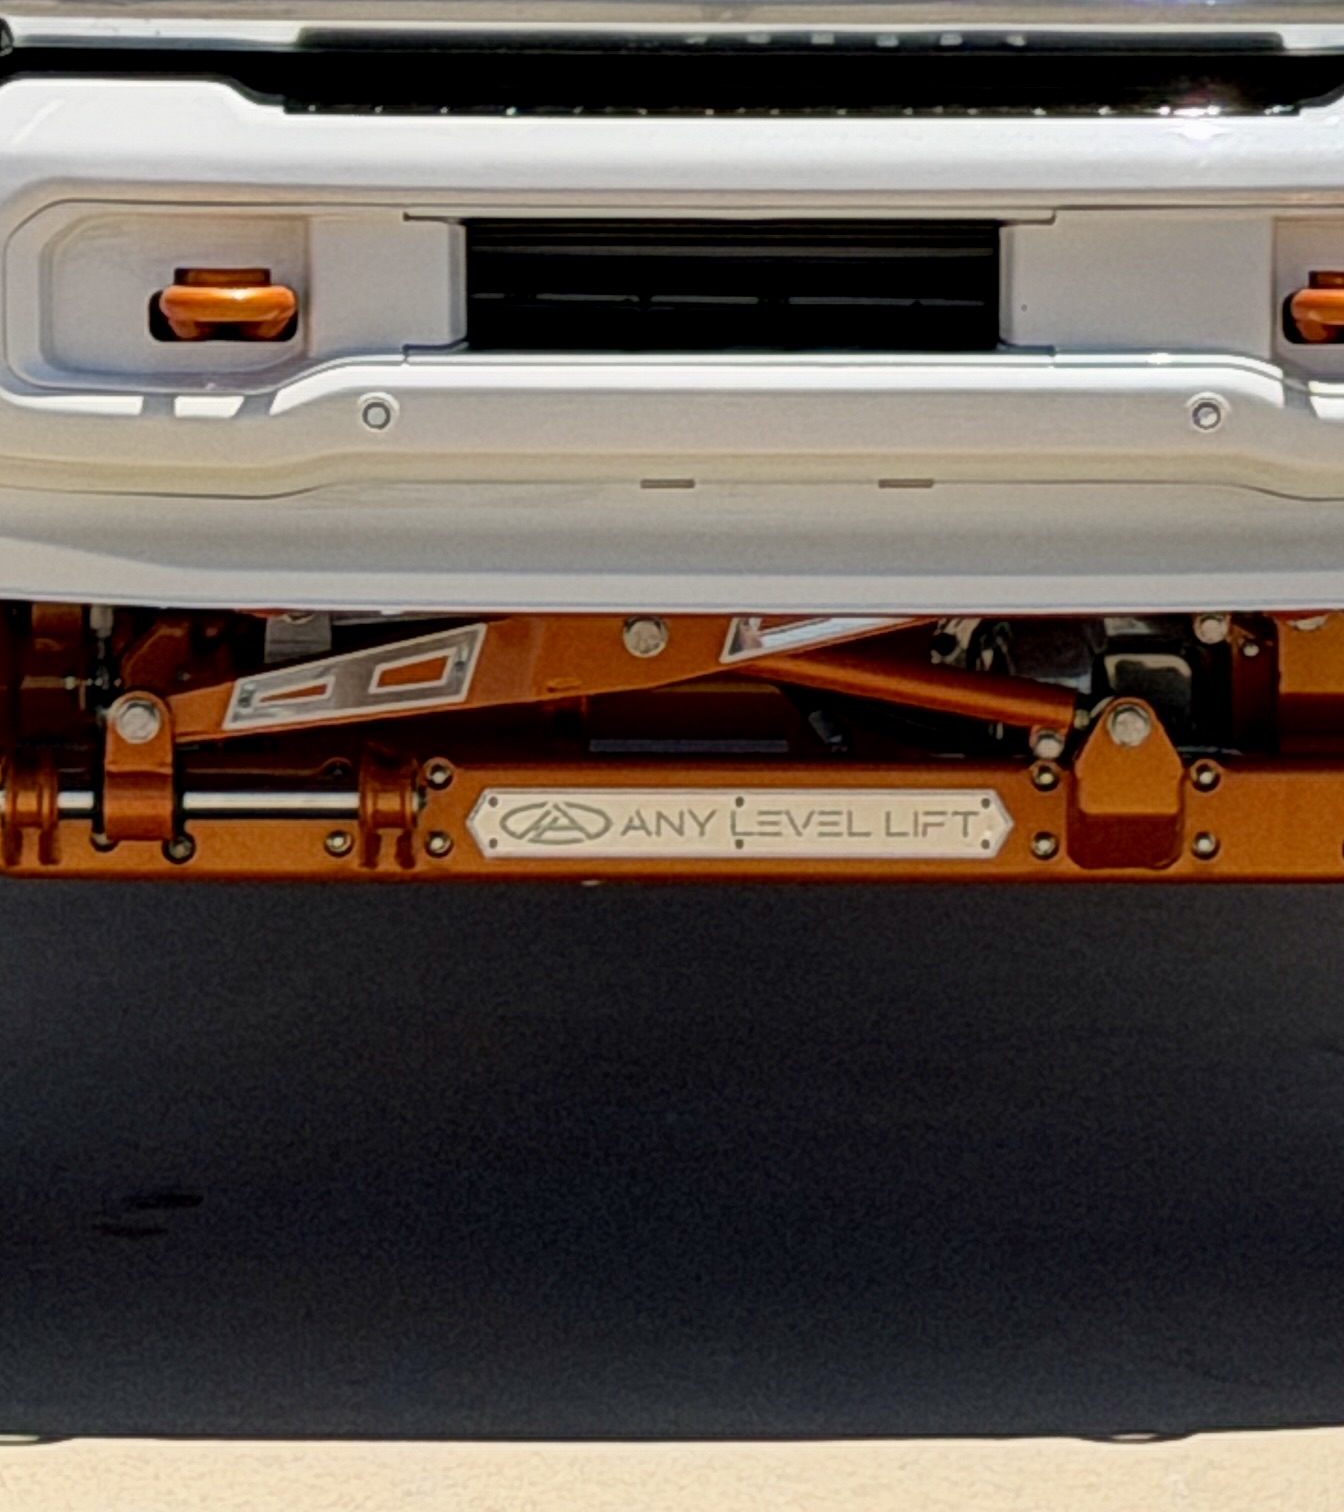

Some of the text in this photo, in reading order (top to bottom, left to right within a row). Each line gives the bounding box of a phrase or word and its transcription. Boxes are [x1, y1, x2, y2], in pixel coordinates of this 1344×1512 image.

[620, 808, 981, 839] ANY LEVEL LIFT
